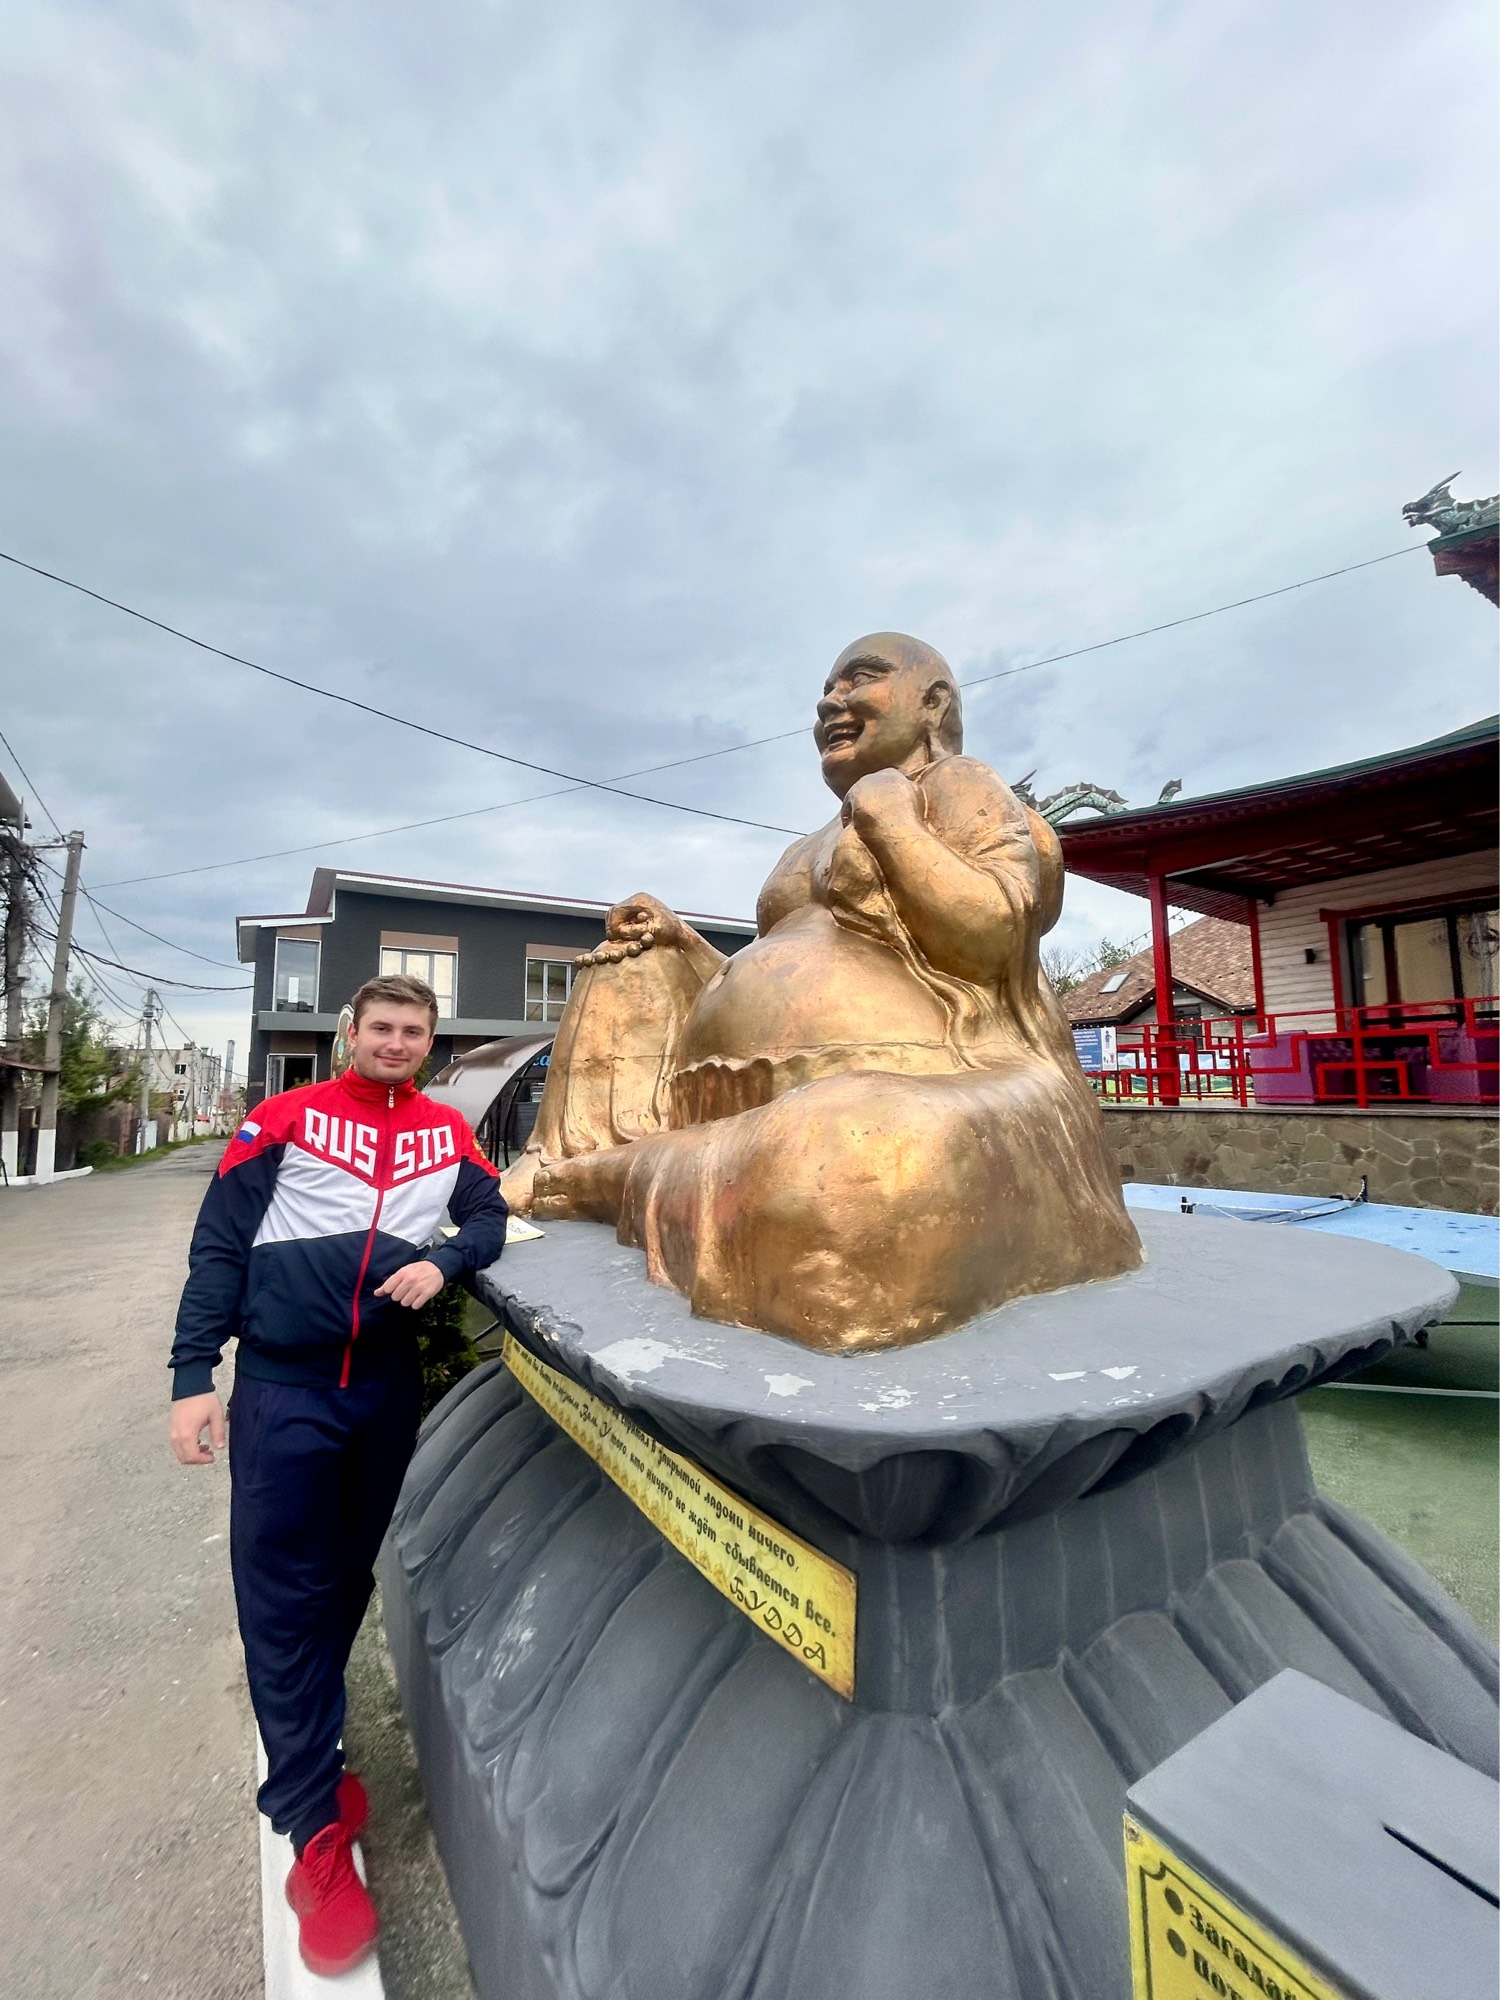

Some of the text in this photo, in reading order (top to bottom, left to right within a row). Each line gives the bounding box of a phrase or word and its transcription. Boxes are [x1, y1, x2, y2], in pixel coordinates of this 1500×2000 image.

[630, 1452, 644, 1472] кто
[646, 1469, 673, 1500] ничего
[676, 1497, 686, 1514] не
[688, 1509, 717, 1543] ждёт
[658, 1448, 701, 1496] закрытой
[704, 1492, 743, 1530] ладони
[748, 1525, 799, 1572] ничего,
[730, 1576, 826, 1670] БУДДА
